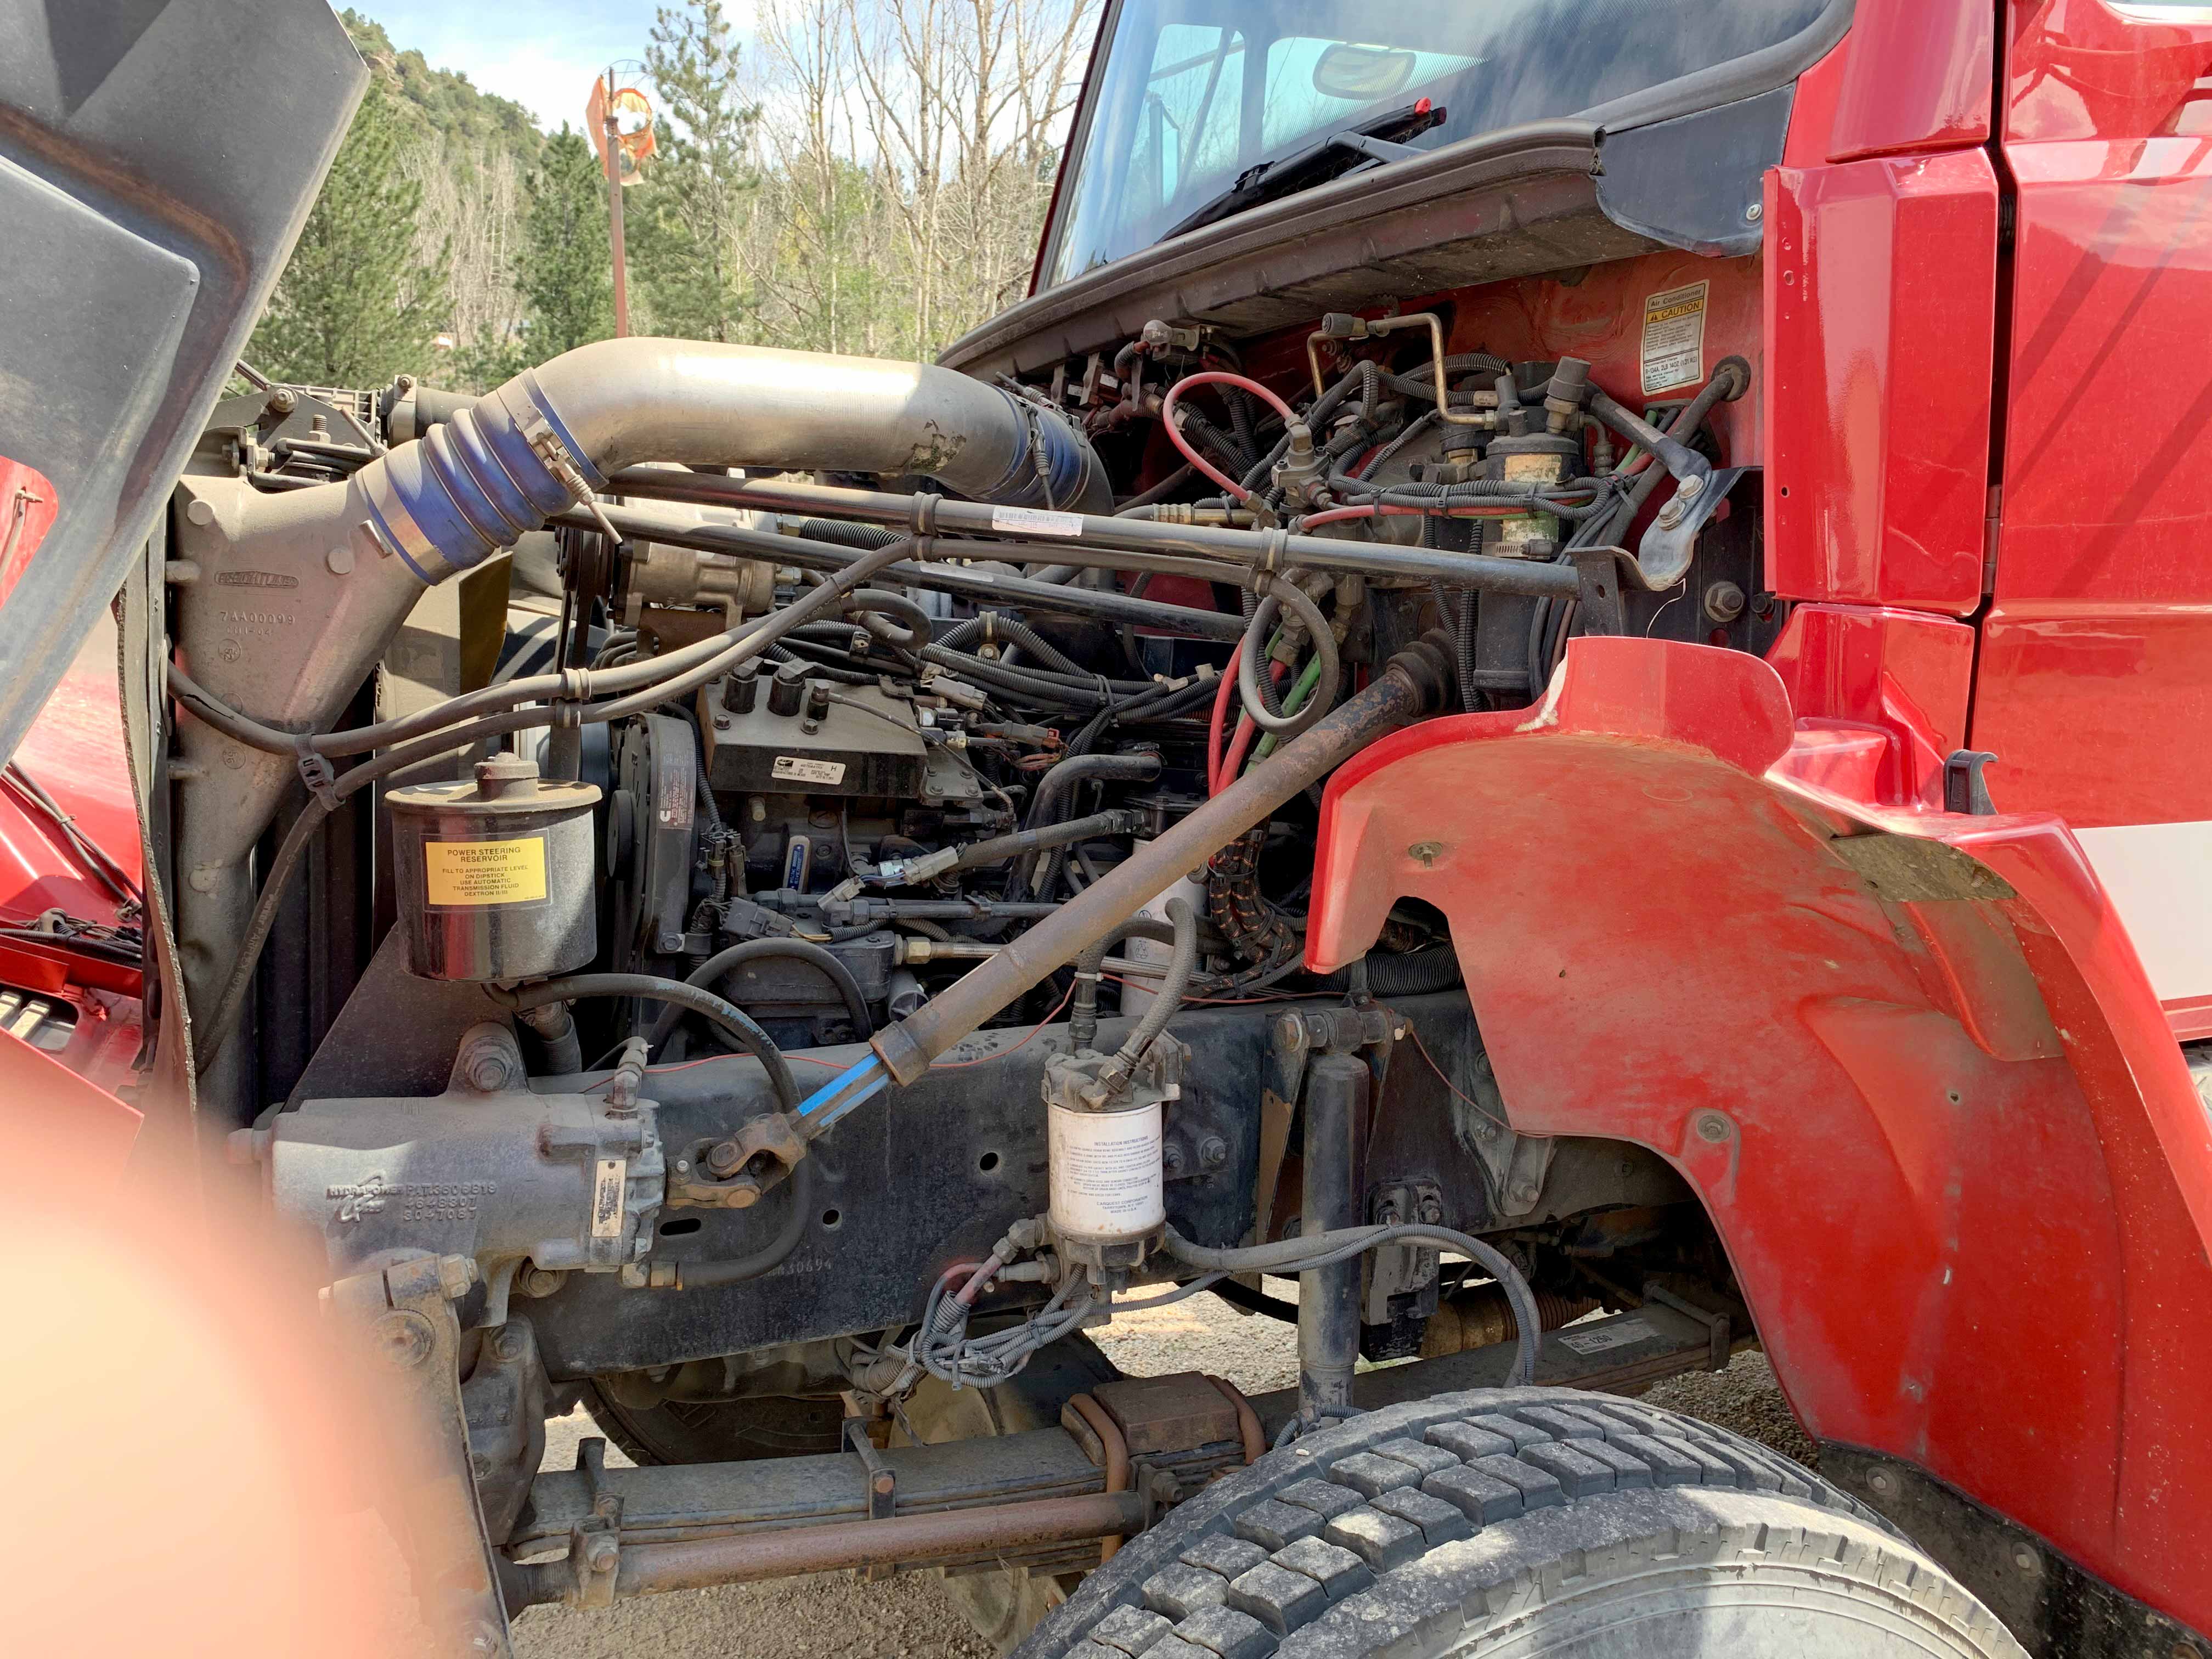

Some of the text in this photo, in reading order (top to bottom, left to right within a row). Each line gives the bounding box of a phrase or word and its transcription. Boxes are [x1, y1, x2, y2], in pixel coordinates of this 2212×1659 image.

[1663, 289, 1702, 304] Conditioner
[1661, 301, 1700, 318] CAUTION
[478, 847, 521, 856] STEERING
[460, 855, 508, 863] RESERVOIR
